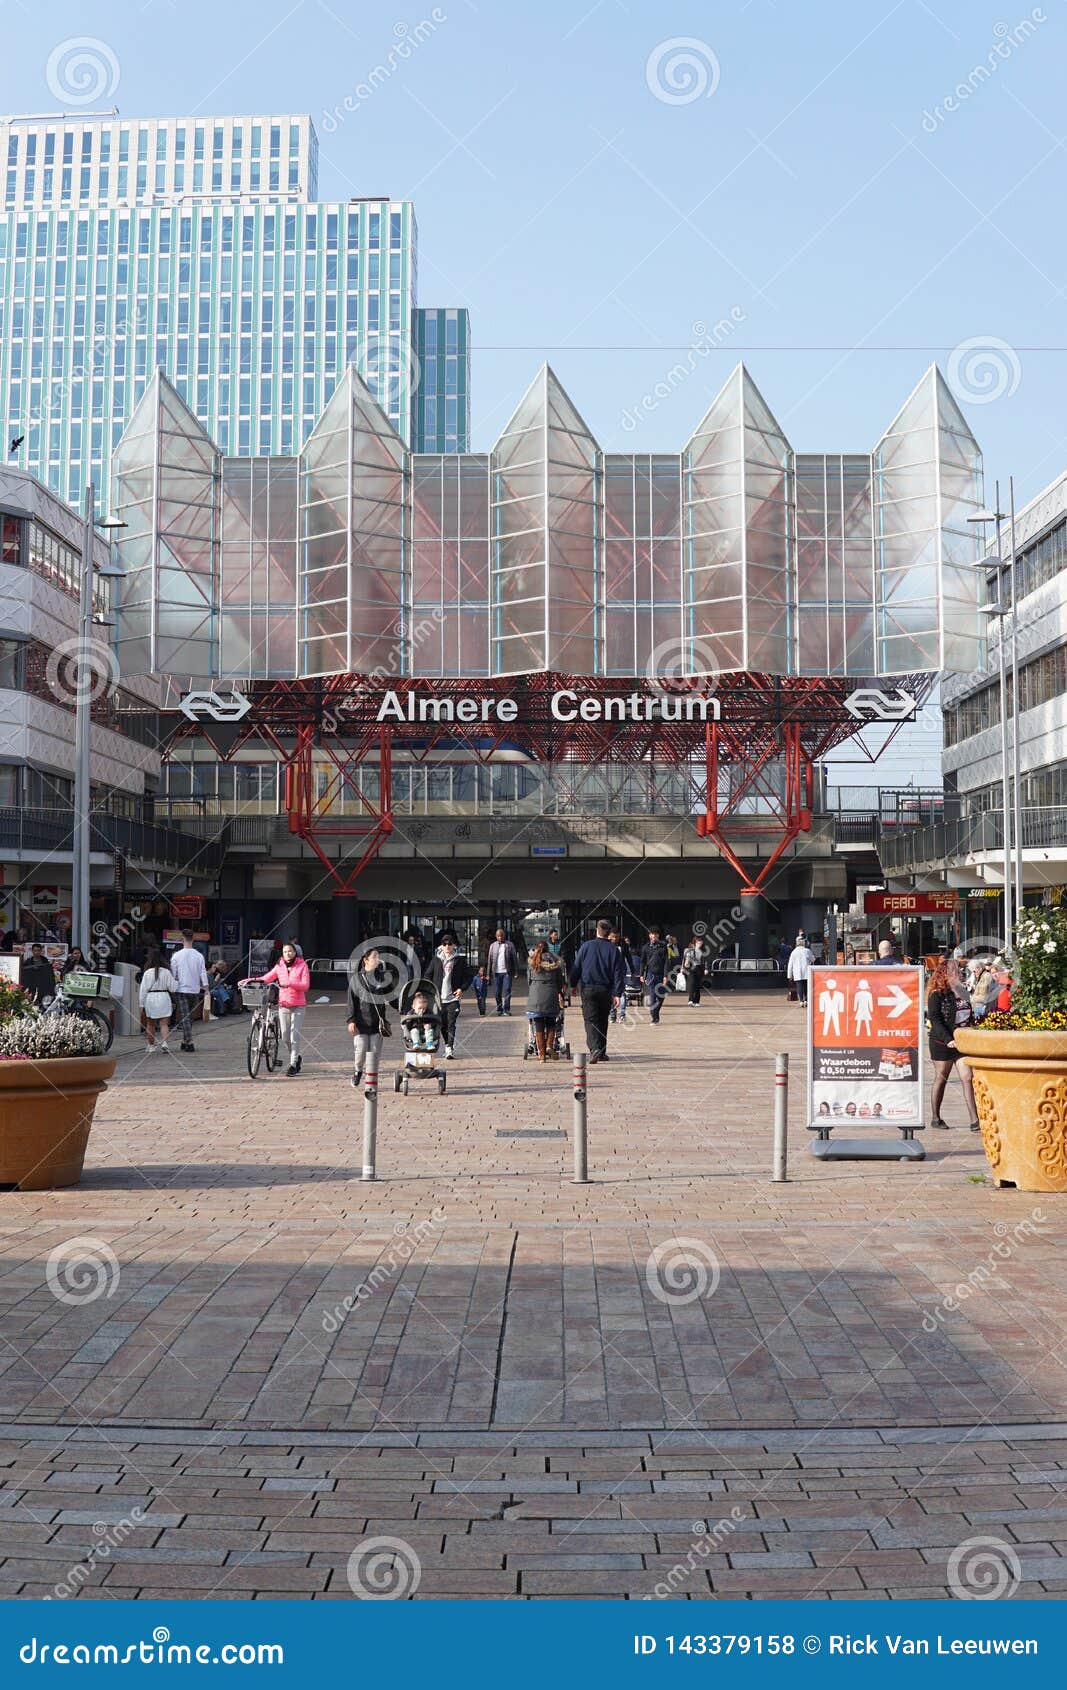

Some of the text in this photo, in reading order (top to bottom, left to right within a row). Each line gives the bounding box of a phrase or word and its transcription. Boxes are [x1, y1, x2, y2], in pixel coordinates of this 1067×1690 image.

[375, 690, 722, 722] Almere Centrum
[967, 888, 1003, 898] SUBWAY
[883, 897, 916, 909] FEBO
[877, 1029, 912, 1037] ENTREE
[819, 1058, 871, 1066] Waardebon
[819, 1066, 826, 1074] €
[827, 1066, 845, 1075] 0,50
